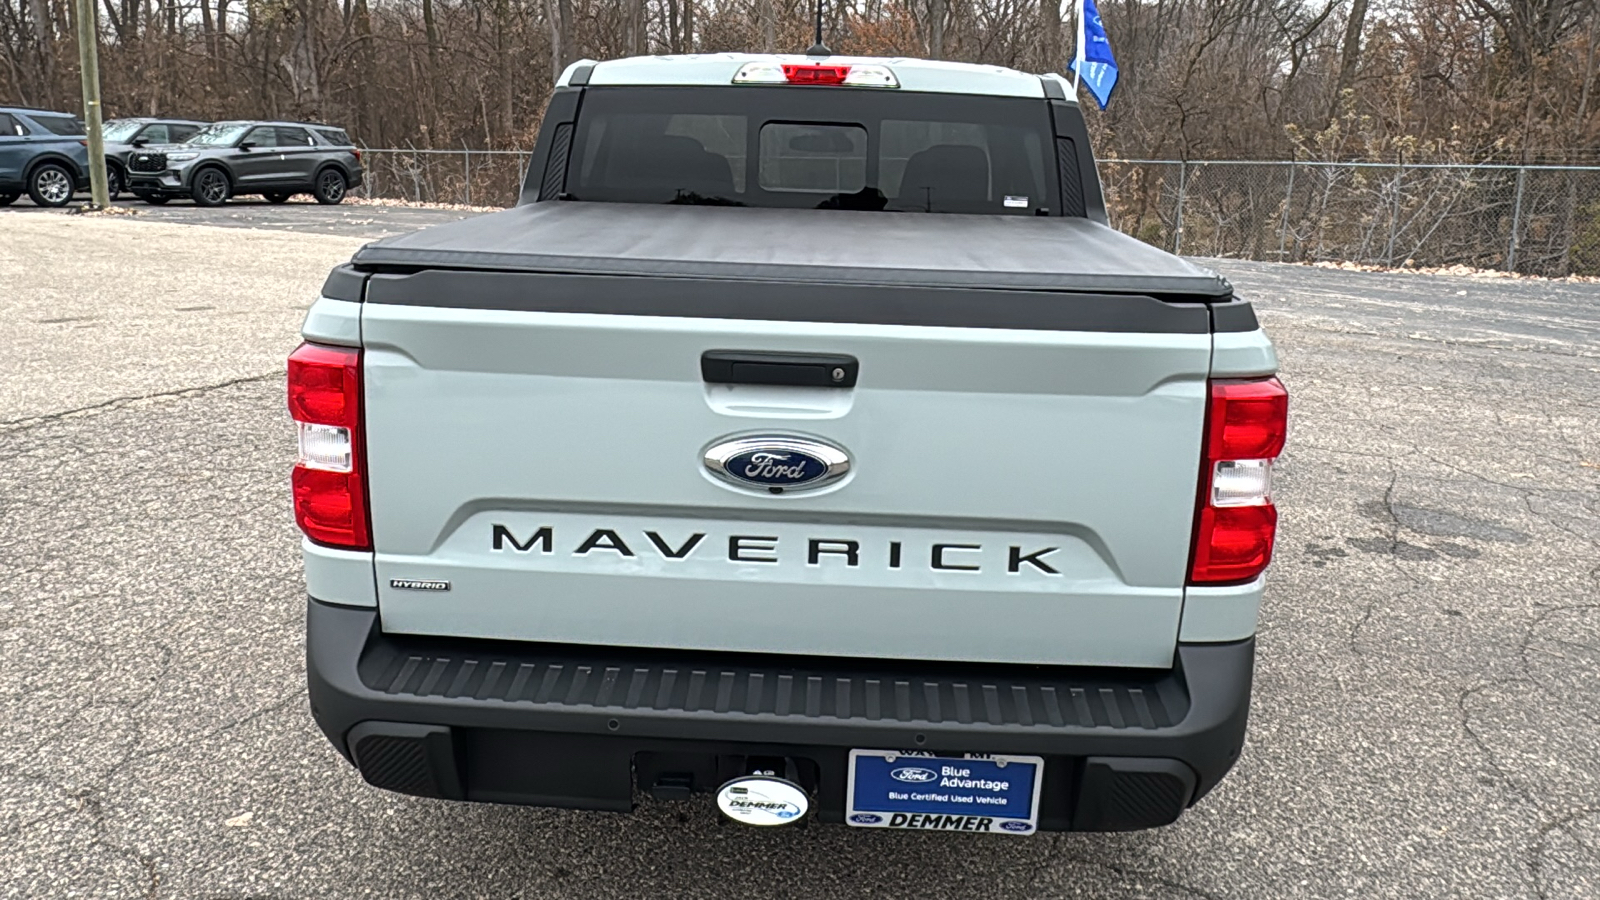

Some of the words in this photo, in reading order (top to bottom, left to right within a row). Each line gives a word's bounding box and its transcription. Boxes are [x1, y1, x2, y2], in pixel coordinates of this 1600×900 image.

[744, 452, 806, 479] Ford
[491, 523, 1062, 575] MAVERICK
[392, 580, 446, 592] HYBRID
[899, 769, 929, 781] Ford
[941, 766, 970, 778] Blue
[940, 777, 1009, 791] Advantage
[889, 791, 909, 801] Blue
[910, 792, 949, 802] Certified
[950, 795, 973, 804] Used
[975, 796, 1008, 805] Vehicle
[729, 800, 787, 810] DEMMER
[855, 813, 877, 823] Ford
[889, 813, 993, 831] DEMMER
[1005, 821, 1027, 831] Ford
